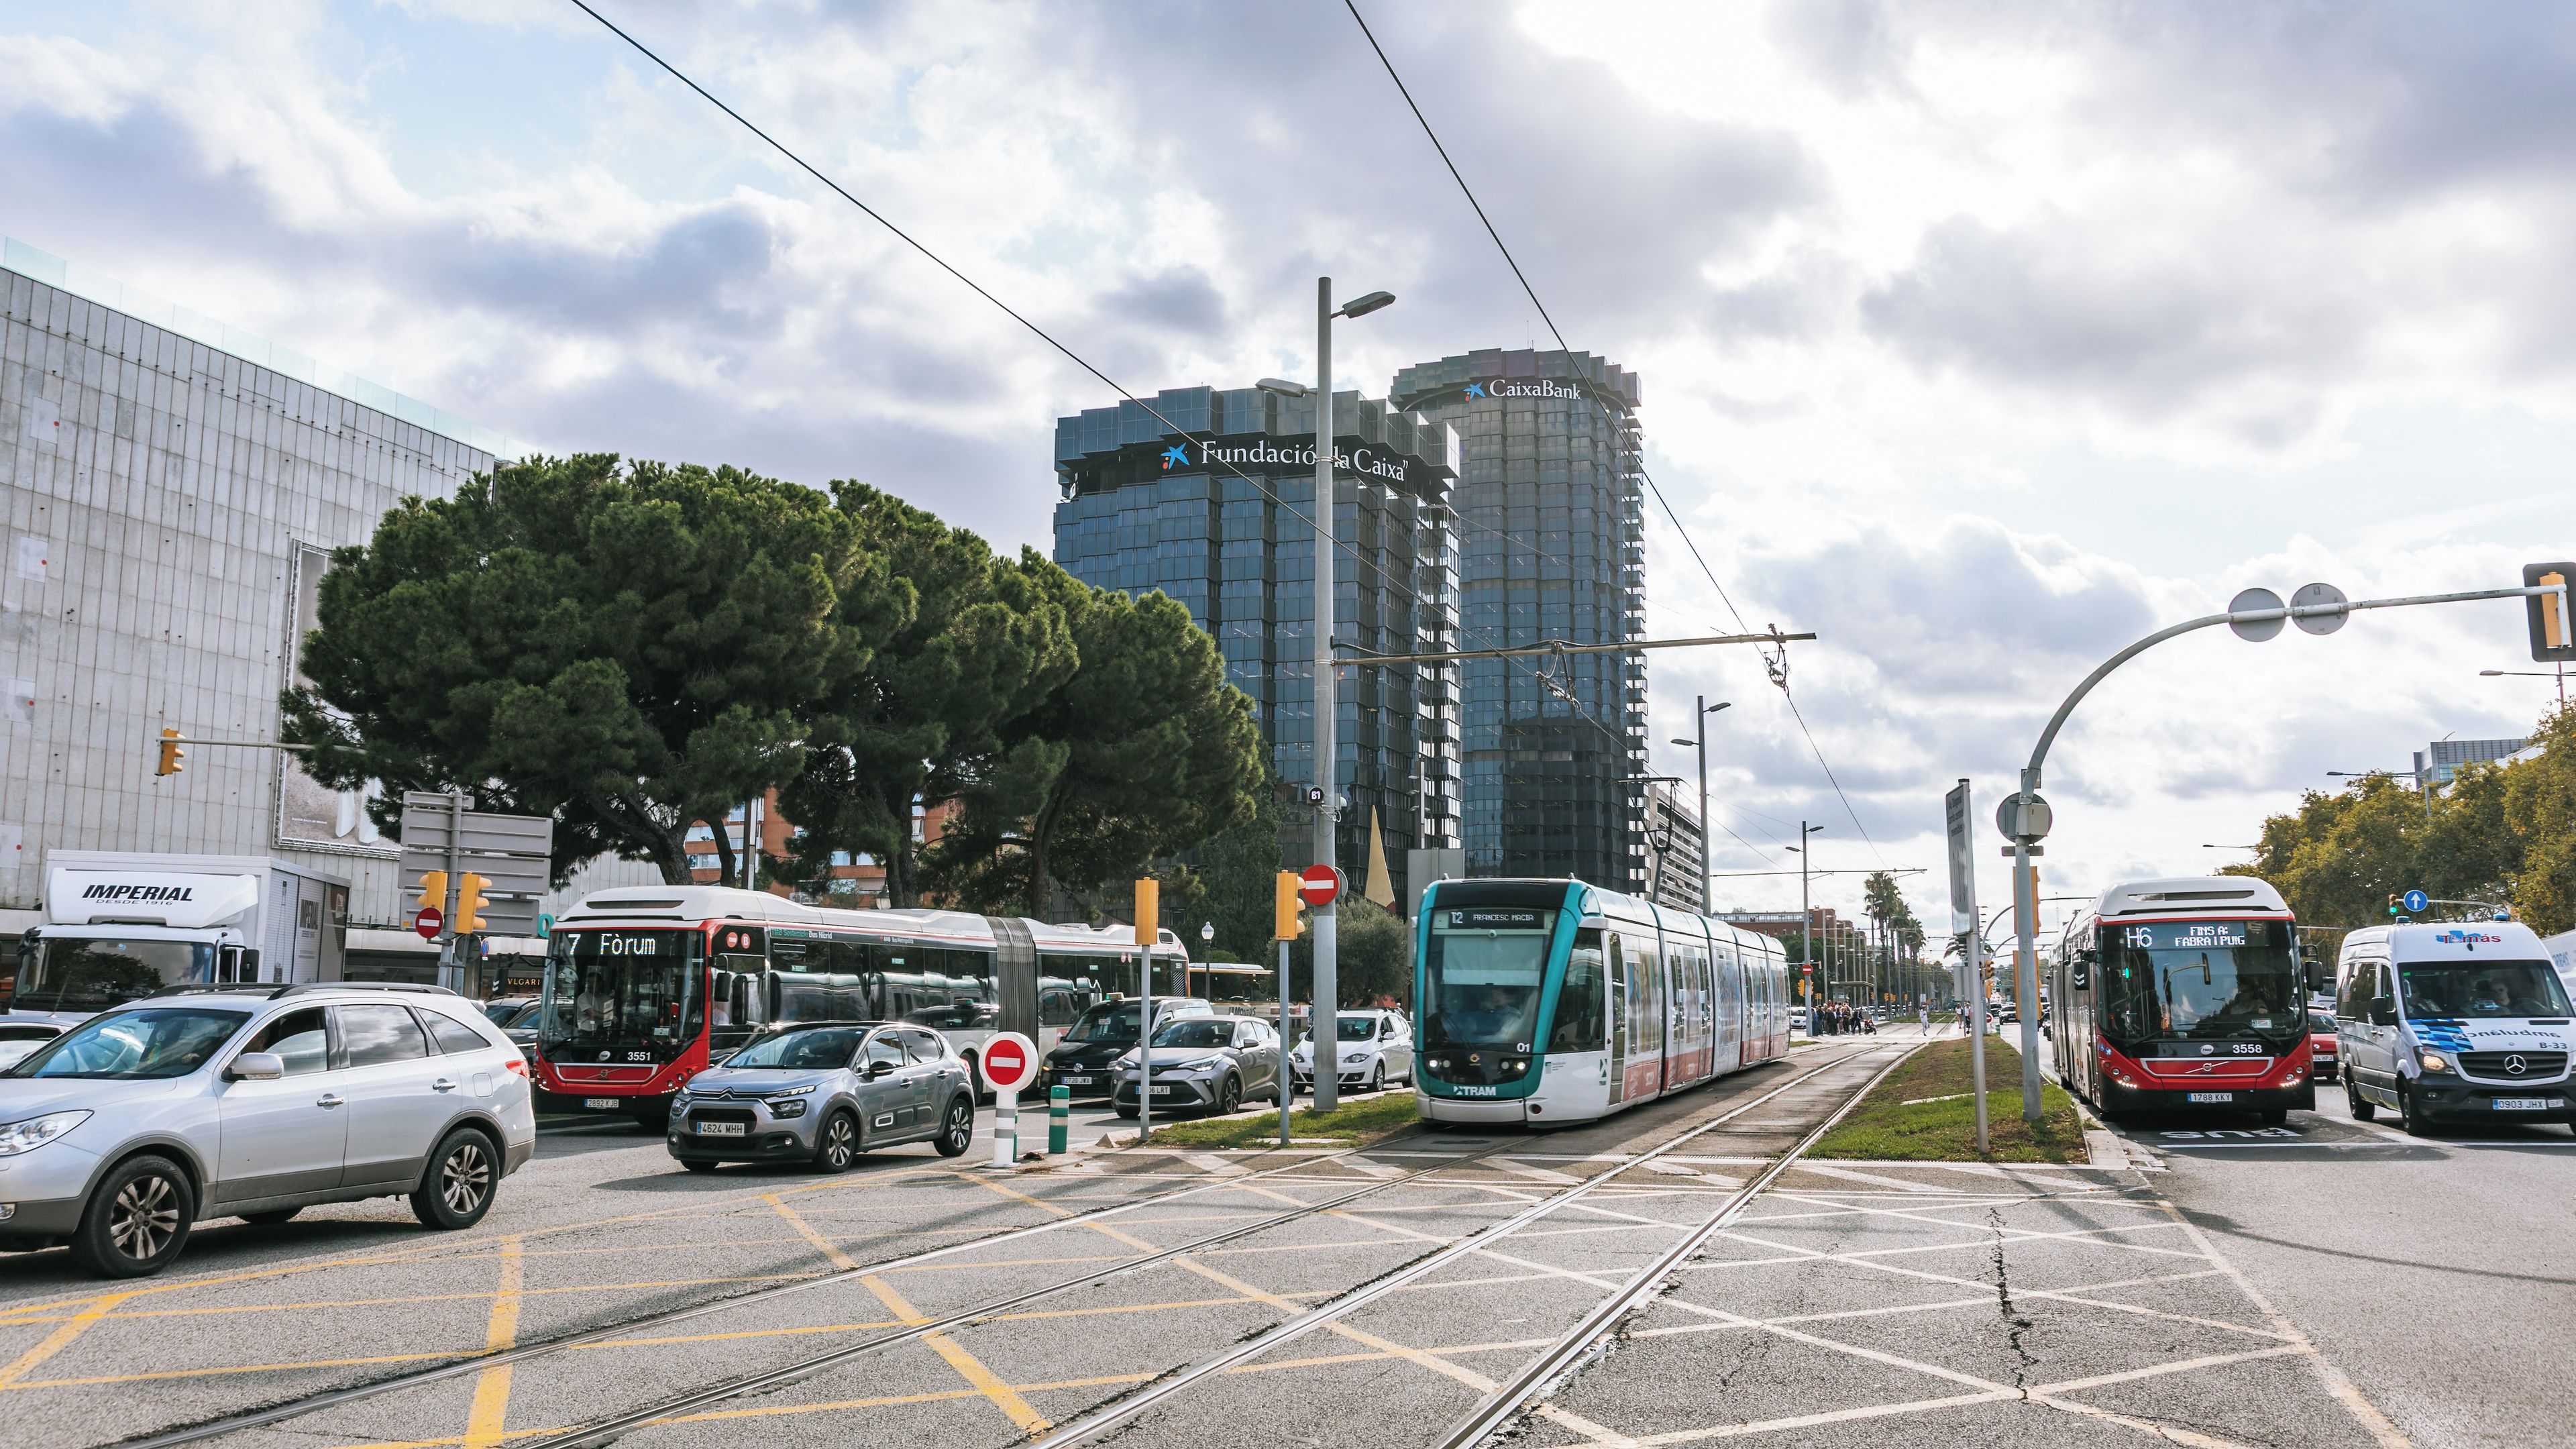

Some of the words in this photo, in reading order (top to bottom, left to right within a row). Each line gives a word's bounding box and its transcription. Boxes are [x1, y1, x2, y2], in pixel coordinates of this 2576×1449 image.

[1489, 380, 1582, 400] CaixaBank
[1201, 440, 1317, 465] Fundació
[1333, 445, 1350, 470] la
[82, 885, 193, 902] IMPERIAL
[1451, 912, 1463, 924] T2
[2126, 927, 2153, 948] H6
[2190, 926, 2214, 936] FINS
[2218, 926, 2229, 935] A:
[2175, 936, 2212, 947] FABRA
[2214, 936, 2218, 946] I
[2220, 936, 2245, 945] PUIG
[568, 934, 581, 955] 7
[600, 933, 655, 955] Fòrum
[1517, 1042, 1530, 1053] 01
[2233, 1044, 2263, 1053] 3558
[627, 1052, 651, 1061] 3551
[1463, 1086, 1496, 1095] TRAM
[2499, 1100, 2522, 1108] 0903
[2526, 1100, 2543, 1108] JHX
[702, 1124, 722, 1133] 4624
[725, 1124, 743, 1134] MHH
[2159, 1127, 2303, 1138] BUS
